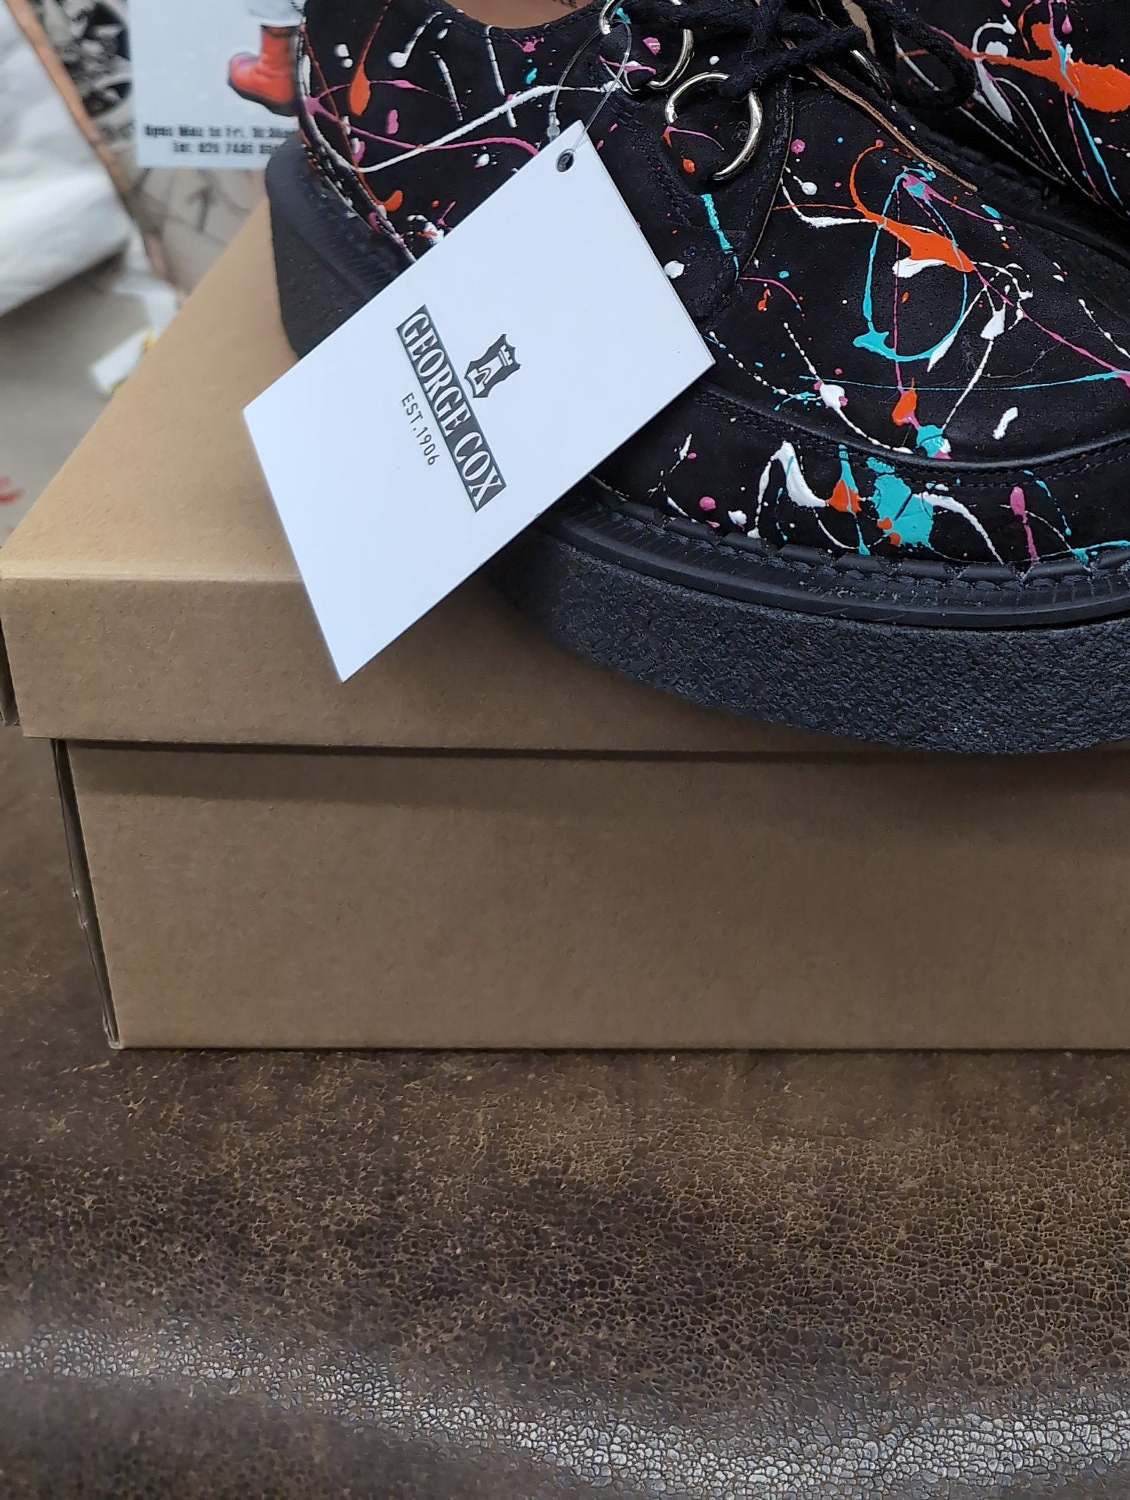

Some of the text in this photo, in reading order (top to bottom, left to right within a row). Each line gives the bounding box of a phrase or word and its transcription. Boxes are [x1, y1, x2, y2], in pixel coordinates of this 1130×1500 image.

[400, 391, 441, 467] EST.1906
[402, 313, 503, 508] GEORGE COX
